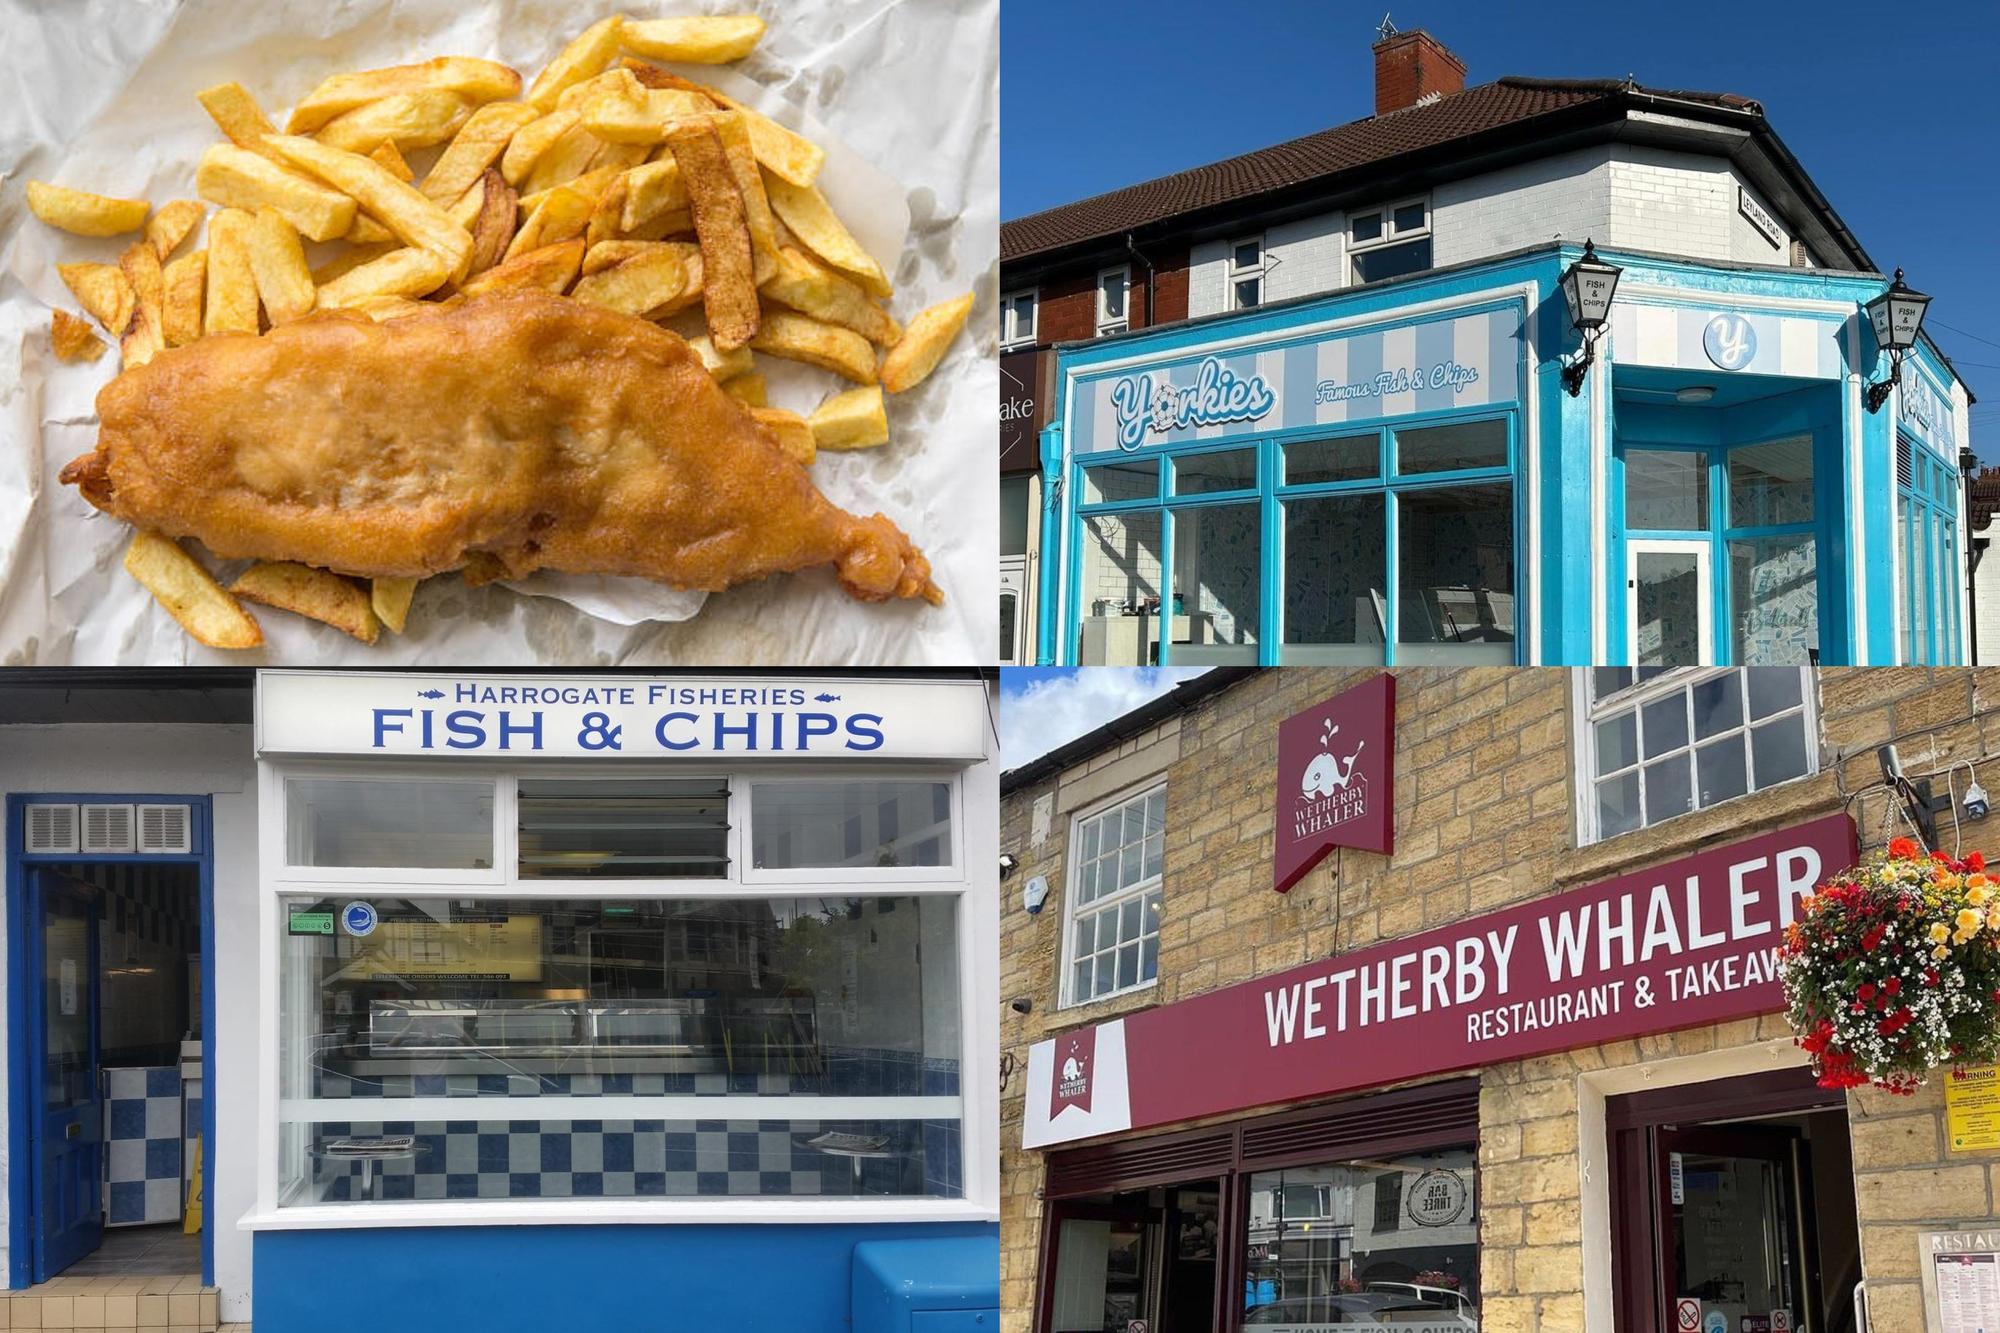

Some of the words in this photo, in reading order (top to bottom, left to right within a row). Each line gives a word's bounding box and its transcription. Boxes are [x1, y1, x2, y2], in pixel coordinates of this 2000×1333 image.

[1743, 195, 1765, 225] LEYLAND
[1766, 218, 1779, 240] ROAD
[1586, 280, 1605, 289] FISH
[1592, 290, 1598, 298] &
[1583, 299, 1606, 308] CHIPS
[1898, 308, 1916, 316] FISH
[1894, 325, 1915, 333] CHIPS
[1315, 379, 1370, 405] Famous
[1373, 368, 1409, 397] Fish
[1411, 369, 1425, 390] &
[1429, 361, 1478, 393] Chips
[1000, 396, 1034, 421] ake
[456, 683, 635, 705] HARROGATE
[648, 685, 806, 706] FISHERIES
[372, 708, 545, 750] FISH
[577, 711, 622, 751] &
[655, 711, 885, 751] CHIPS
[1294, 786, 1364, 821] WETHERBY
[1294, 800, 1365, 838] WHALER
[1265, 925, 1517, 1046] WETHERBY
[1539, 846, 1822, 982] WHALER
[1467, 981, 1624, 1043] RESTAURANT
[1635, 975, 1656, 1008] &
[1952, 1070, 1996, 1081] RNING
[1059, 1085, 1087, 1098] WHALER
